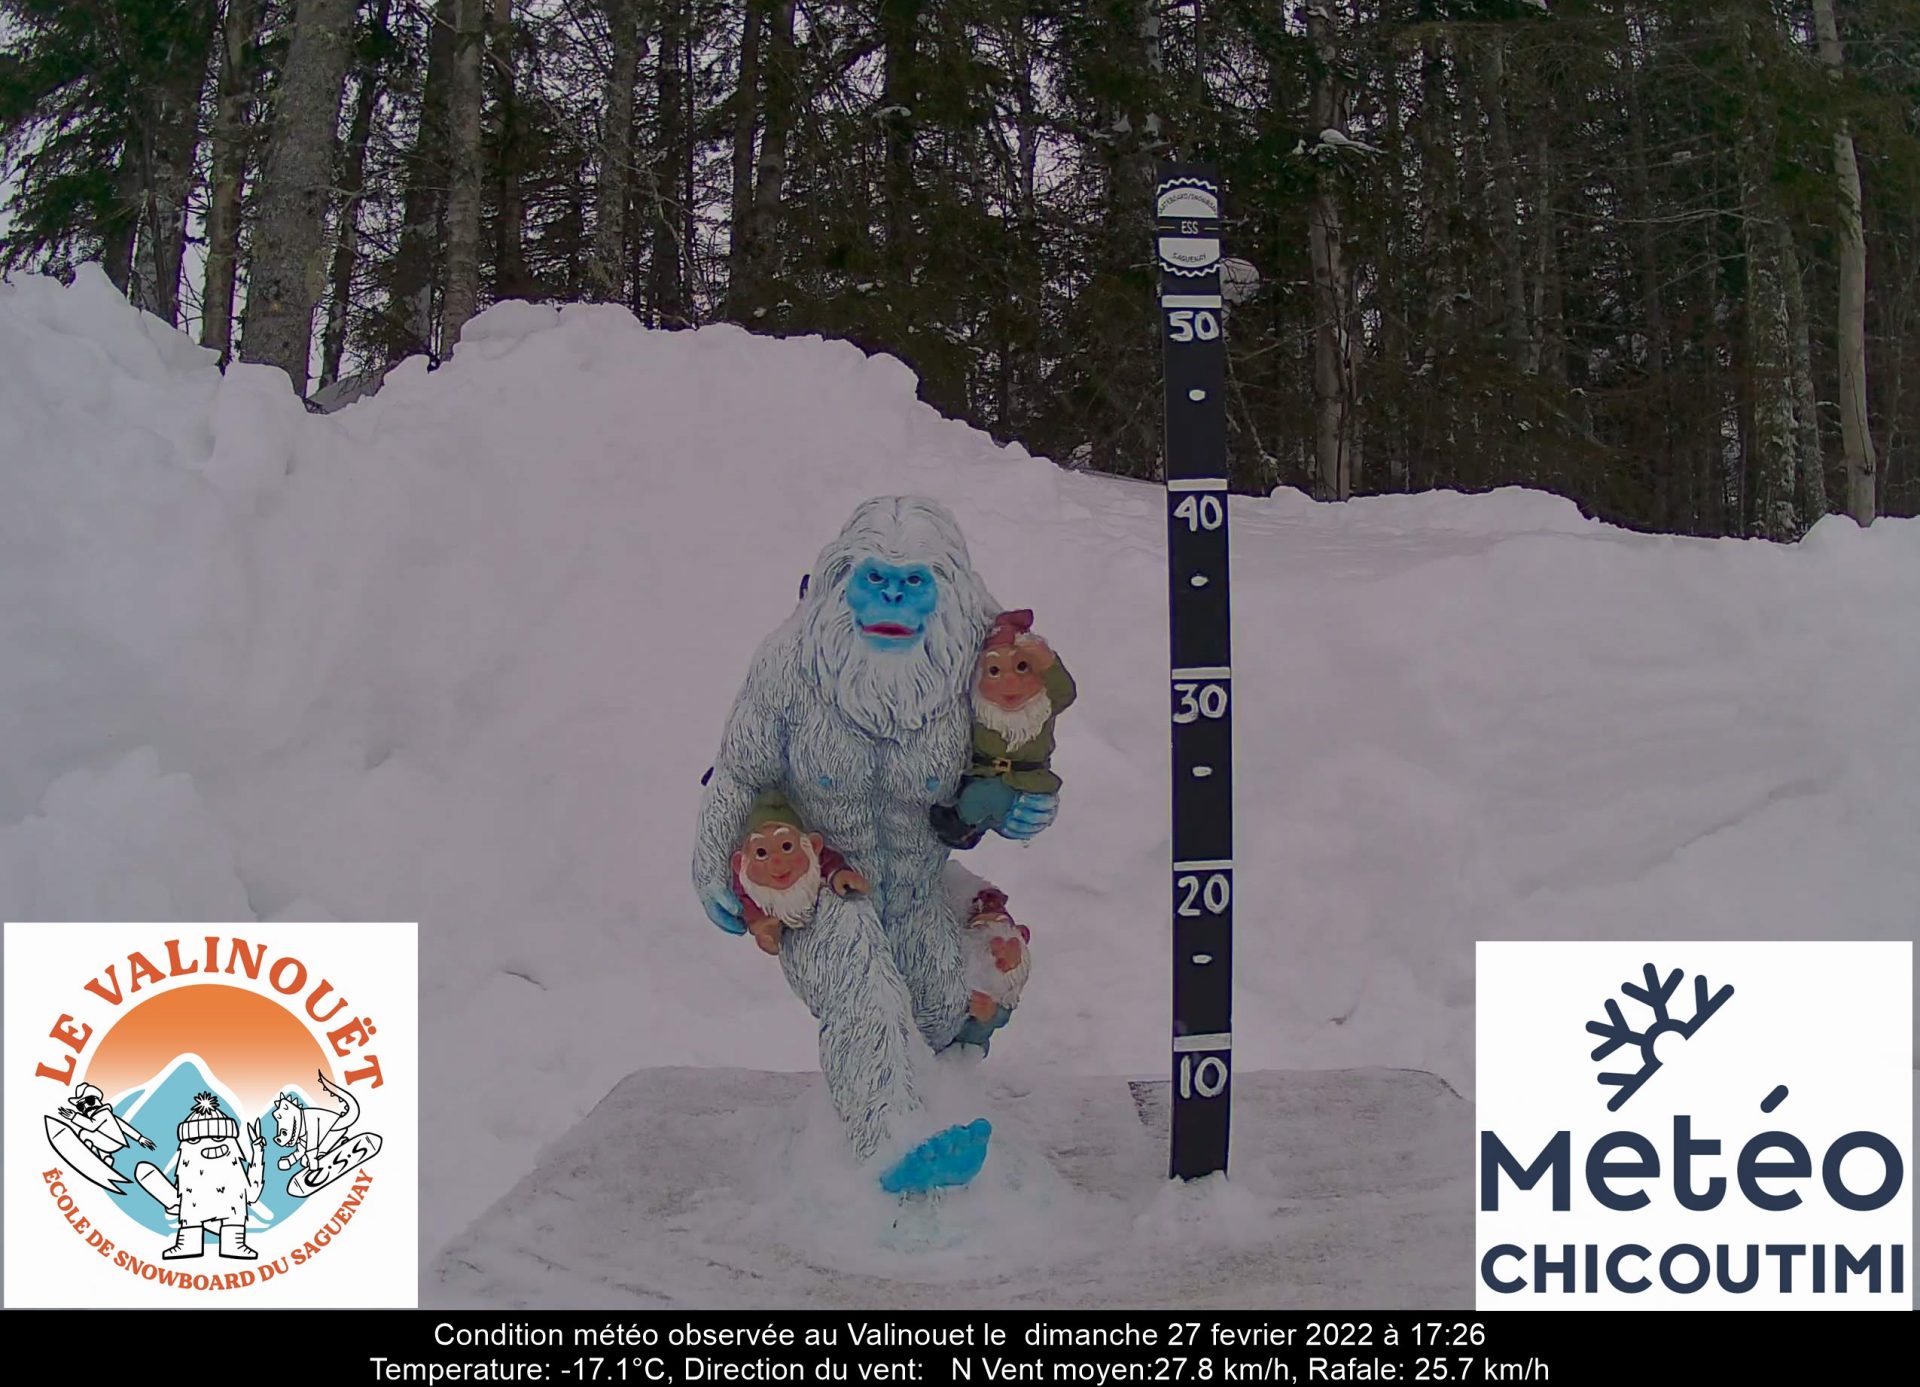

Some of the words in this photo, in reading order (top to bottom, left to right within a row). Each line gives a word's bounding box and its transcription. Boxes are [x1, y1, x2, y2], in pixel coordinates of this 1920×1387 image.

[1181, 221, 1199, 234] ESS
[1168, 311, 1219, 342] 50
[1173, 495, 1223, 532] 40
[1173, 683, 1227, 723] 30
[1177, 874, 1230, 916] 20
[1180, 1055, 1227, 1098] 10
